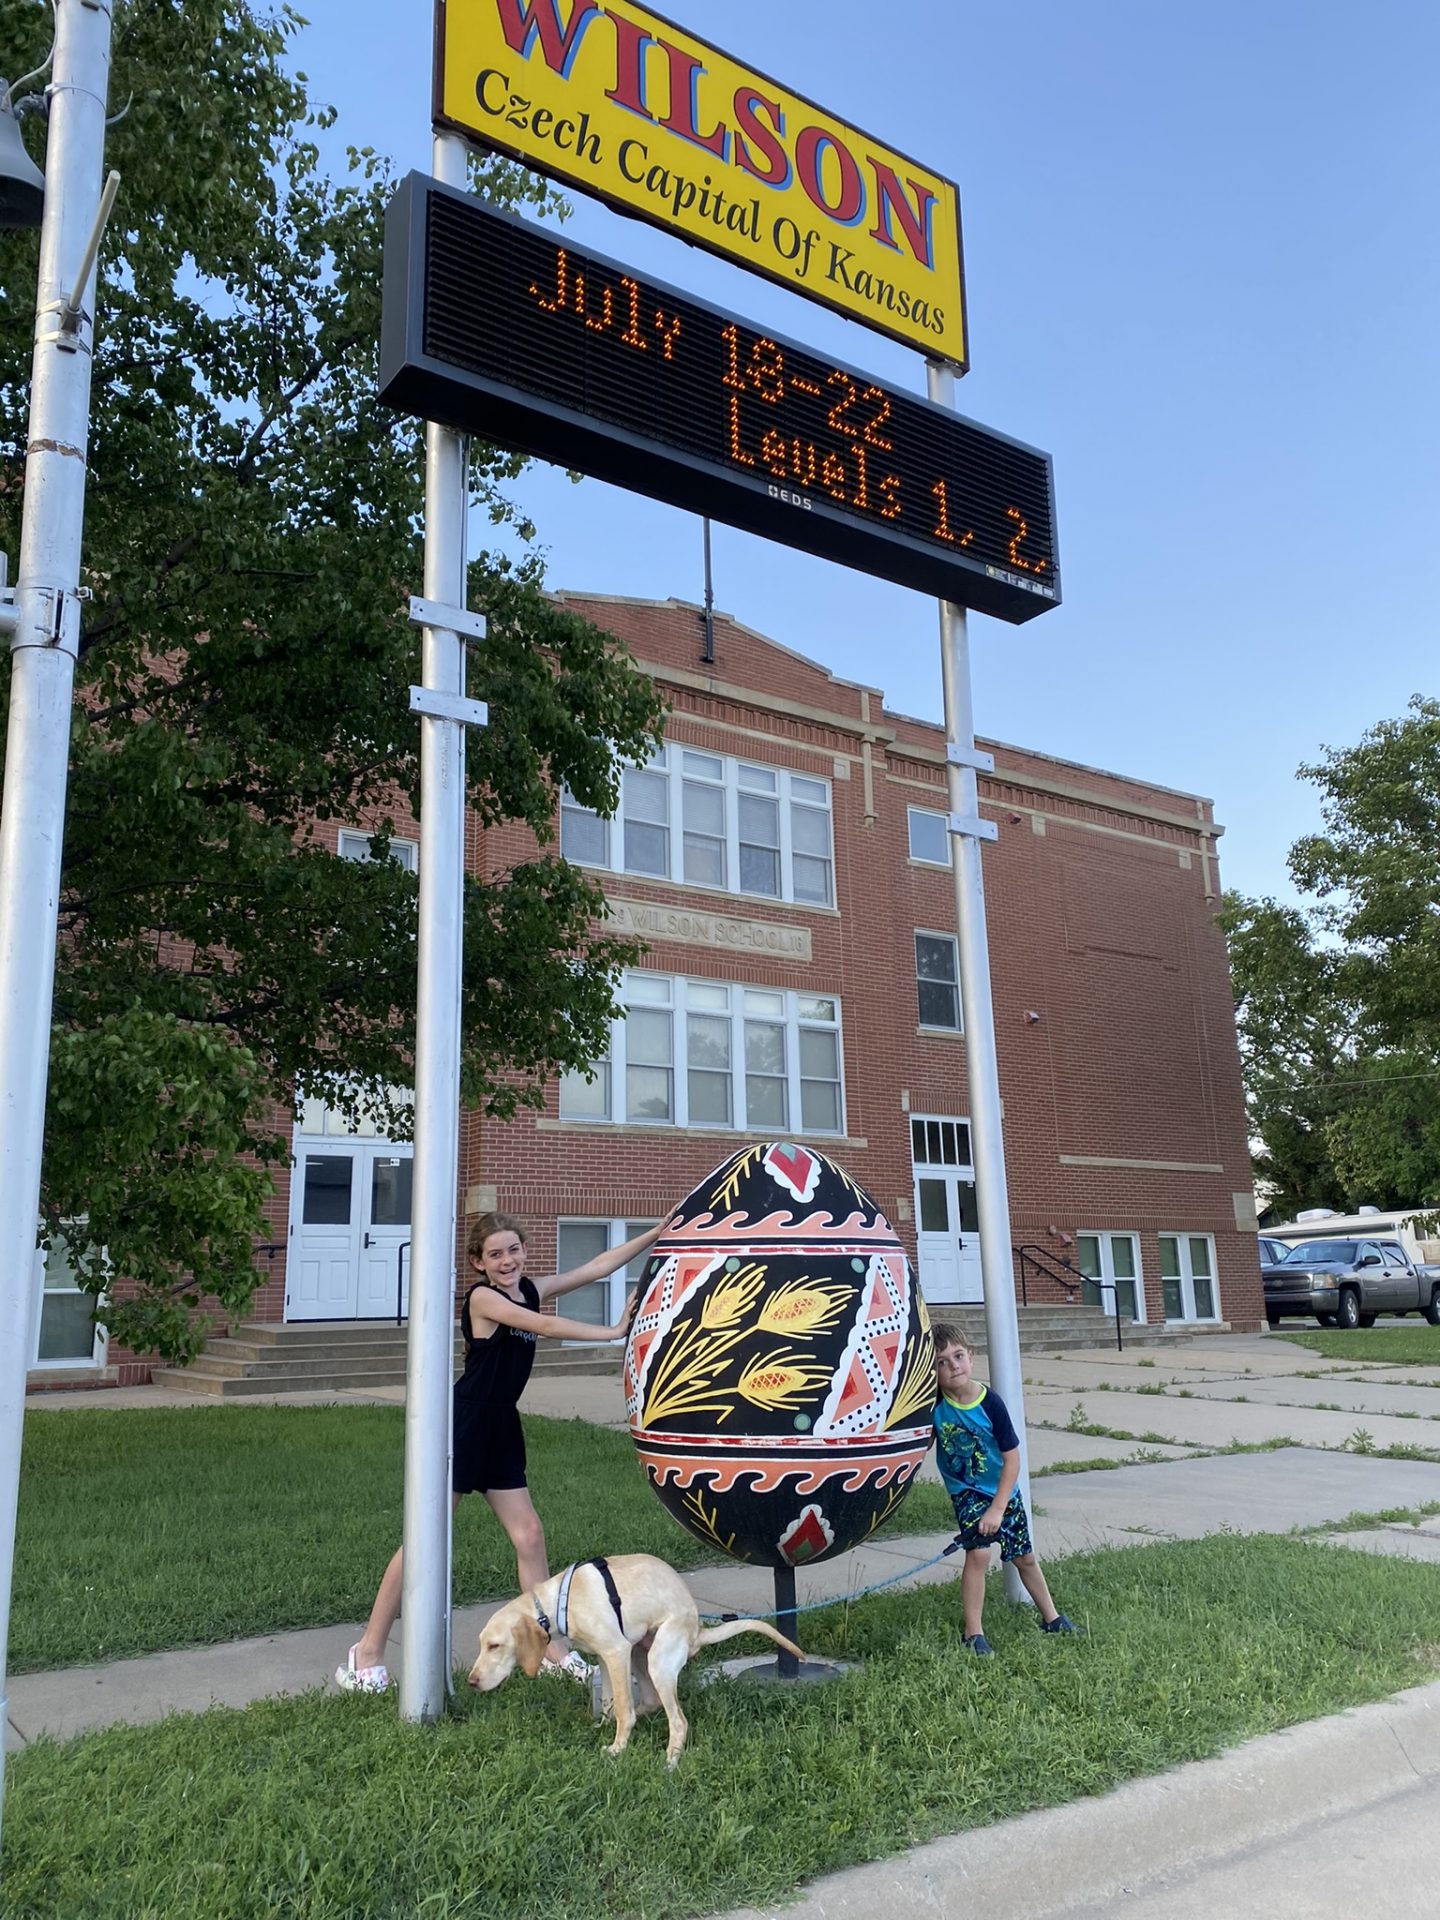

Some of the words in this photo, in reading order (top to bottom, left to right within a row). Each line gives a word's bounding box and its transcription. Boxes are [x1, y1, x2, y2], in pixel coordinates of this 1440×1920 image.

[475, 68, 603, 165] Czech
[618, 139, 763, 243] Capital
[772, 216, 821, 278] Of
[825, 240, 946, 335] Kansas
[495, 0, 939, 272] WILSON
[721, 324, 893, 450] 18-22
[729, 396, 902, 518] Levels
[932, 481, 974, 545] 1,
[780, 489, 812, 511] EDS
[627, 906, 710, 942] WILSON
[714, 921, 790, 952] SCHOOL
